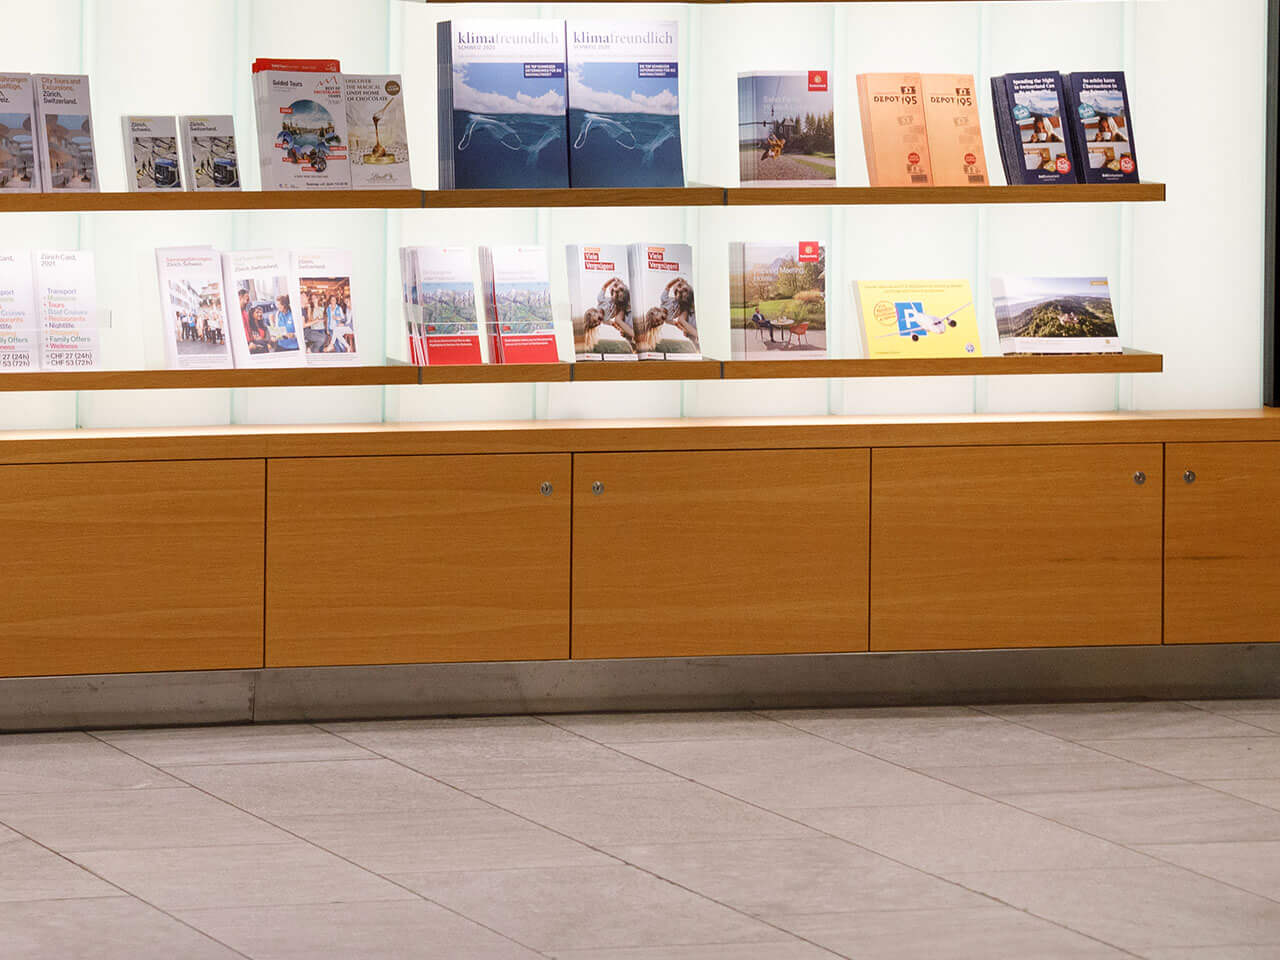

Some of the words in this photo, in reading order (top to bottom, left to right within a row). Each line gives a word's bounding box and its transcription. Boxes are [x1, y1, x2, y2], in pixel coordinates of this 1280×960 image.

[457, 31, 560, 45] klimafreundlich
[573, 31, 674, 45] klimafreundlich
[873, 95, 900, 103] DEPOT
[930, 96, 955, 104] DEPOT
[47, 287, 77, 296] Transport
[49, 335, 70, 343] Family
[12, 353, 30, 361] (24h)
[74, 352, 93, 360] (24h)
[12, 360, 30, 368] (72h)
[75, 359, 93, 367] (72h)
